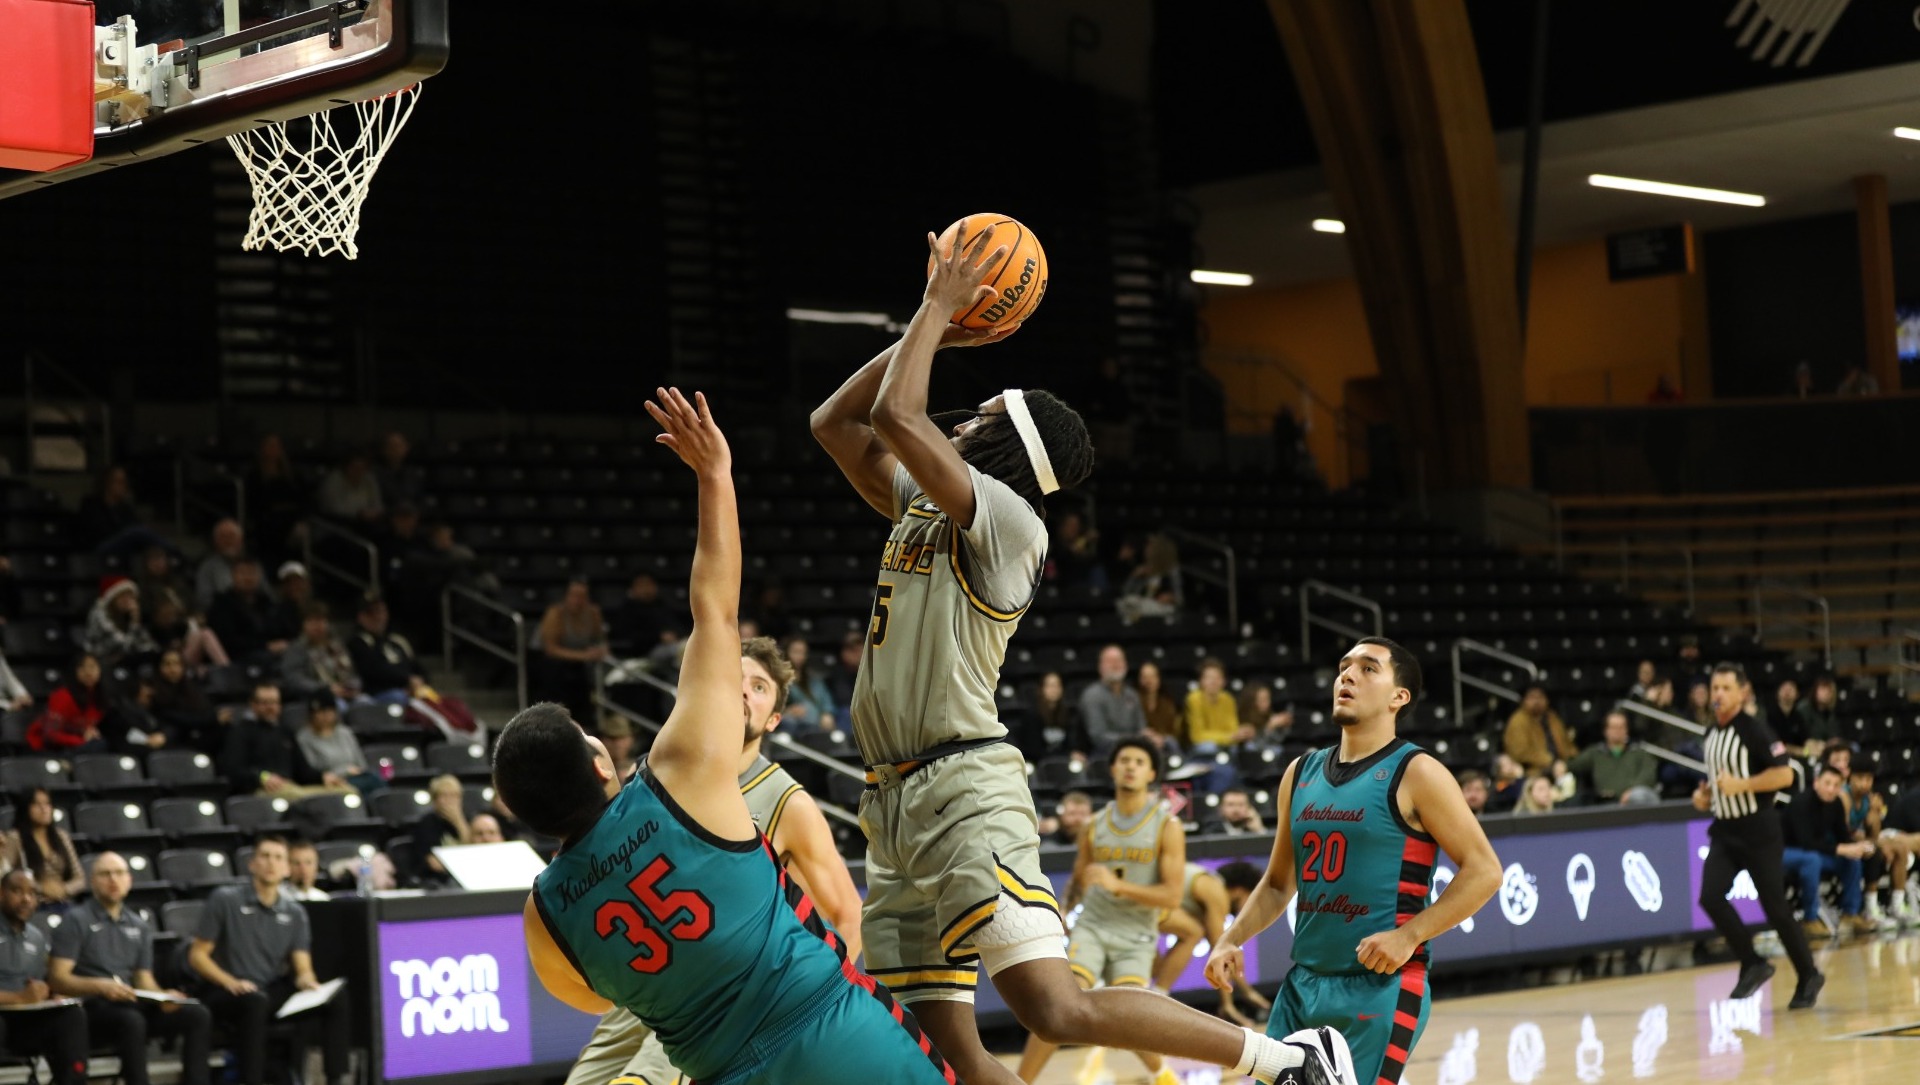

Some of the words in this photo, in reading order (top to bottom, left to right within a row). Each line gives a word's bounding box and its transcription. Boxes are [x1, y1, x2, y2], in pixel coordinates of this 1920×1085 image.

[978, 258, 1036, 323] Wilson
[1296, 801, 1365, 822] Northwest
[555, 818, 660, 913] Kwelengsen
[1302, 830, 1347, 883] 20
[594, 852, 716, 976] 35
[1316, 893, 1370, 923] College
[389, 953, 499, 999] nom
[401, 991, 510, 1039] nom
